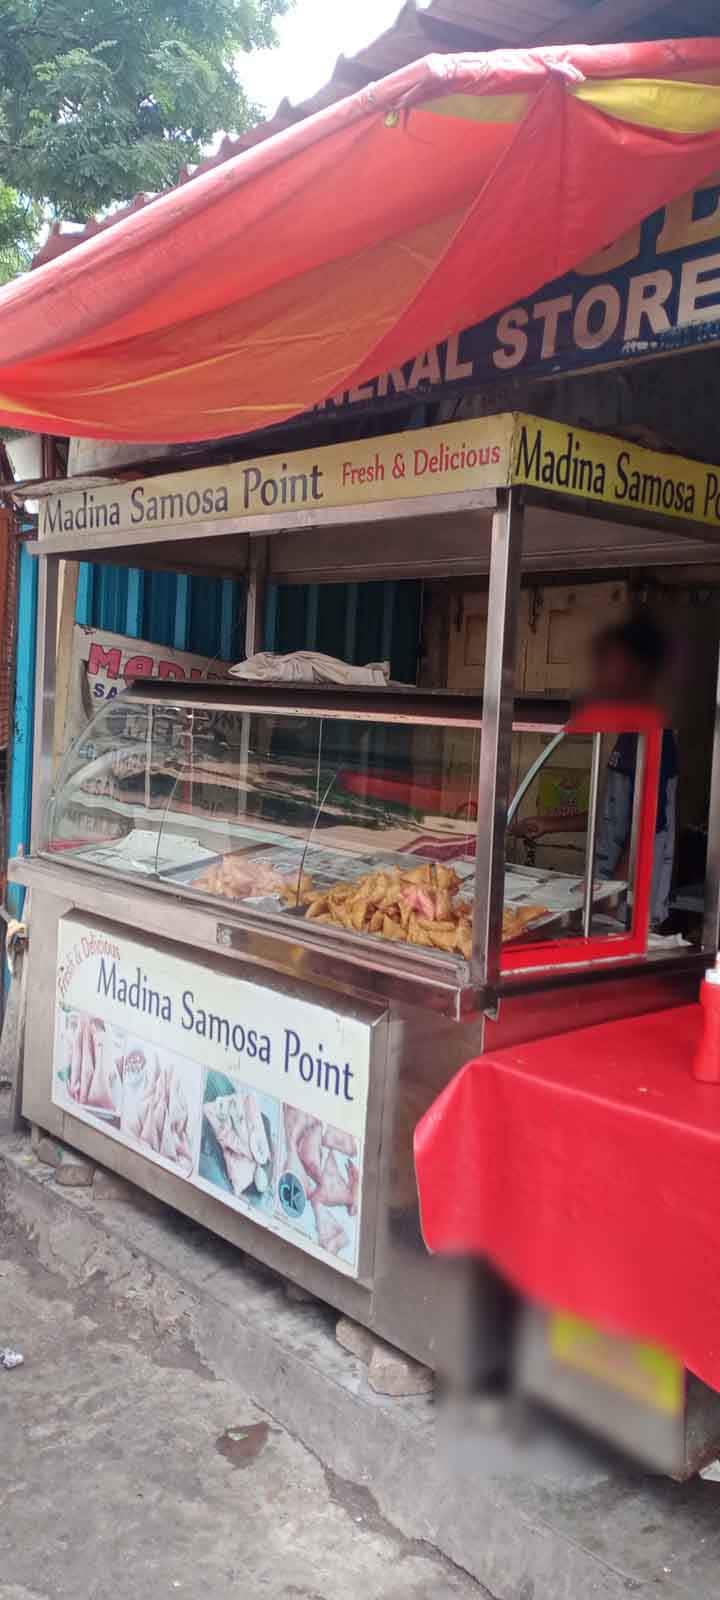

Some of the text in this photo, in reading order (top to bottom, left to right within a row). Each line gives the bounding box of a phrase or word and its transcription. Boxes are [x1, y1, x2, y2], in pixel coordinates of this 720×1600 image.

[492, 253, 720, 369] STORE
[42, 442, 502, 535] Madina Samosa Point Fresh & Delicious
[515, 426, 605, 496] Madina
[614, 451, 696, 513] Samosa
[97, 958, 354, 1101] Madina Samosa Point
